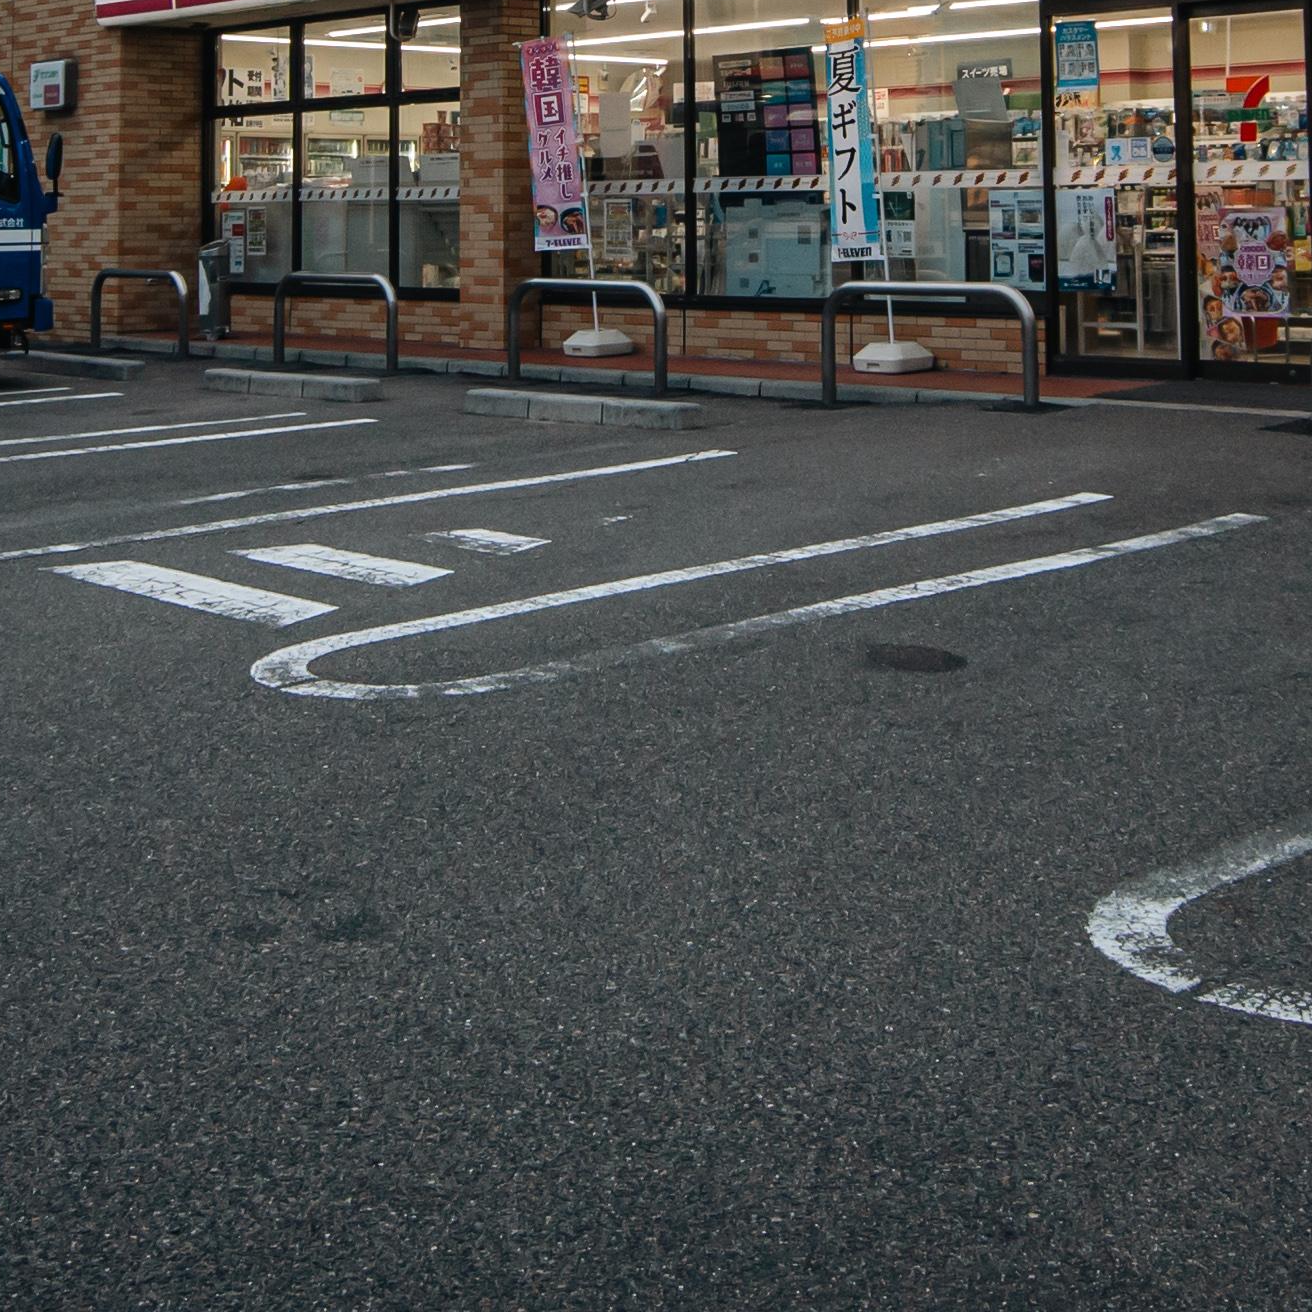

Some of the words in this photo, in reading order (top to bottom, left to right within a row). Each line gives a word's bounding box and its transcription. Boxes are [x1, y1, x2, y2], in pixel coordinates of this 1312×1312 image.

[961, 64, 1008, 79] スイーツ売場
[829, 45, 861, 225] 夏ギフト
